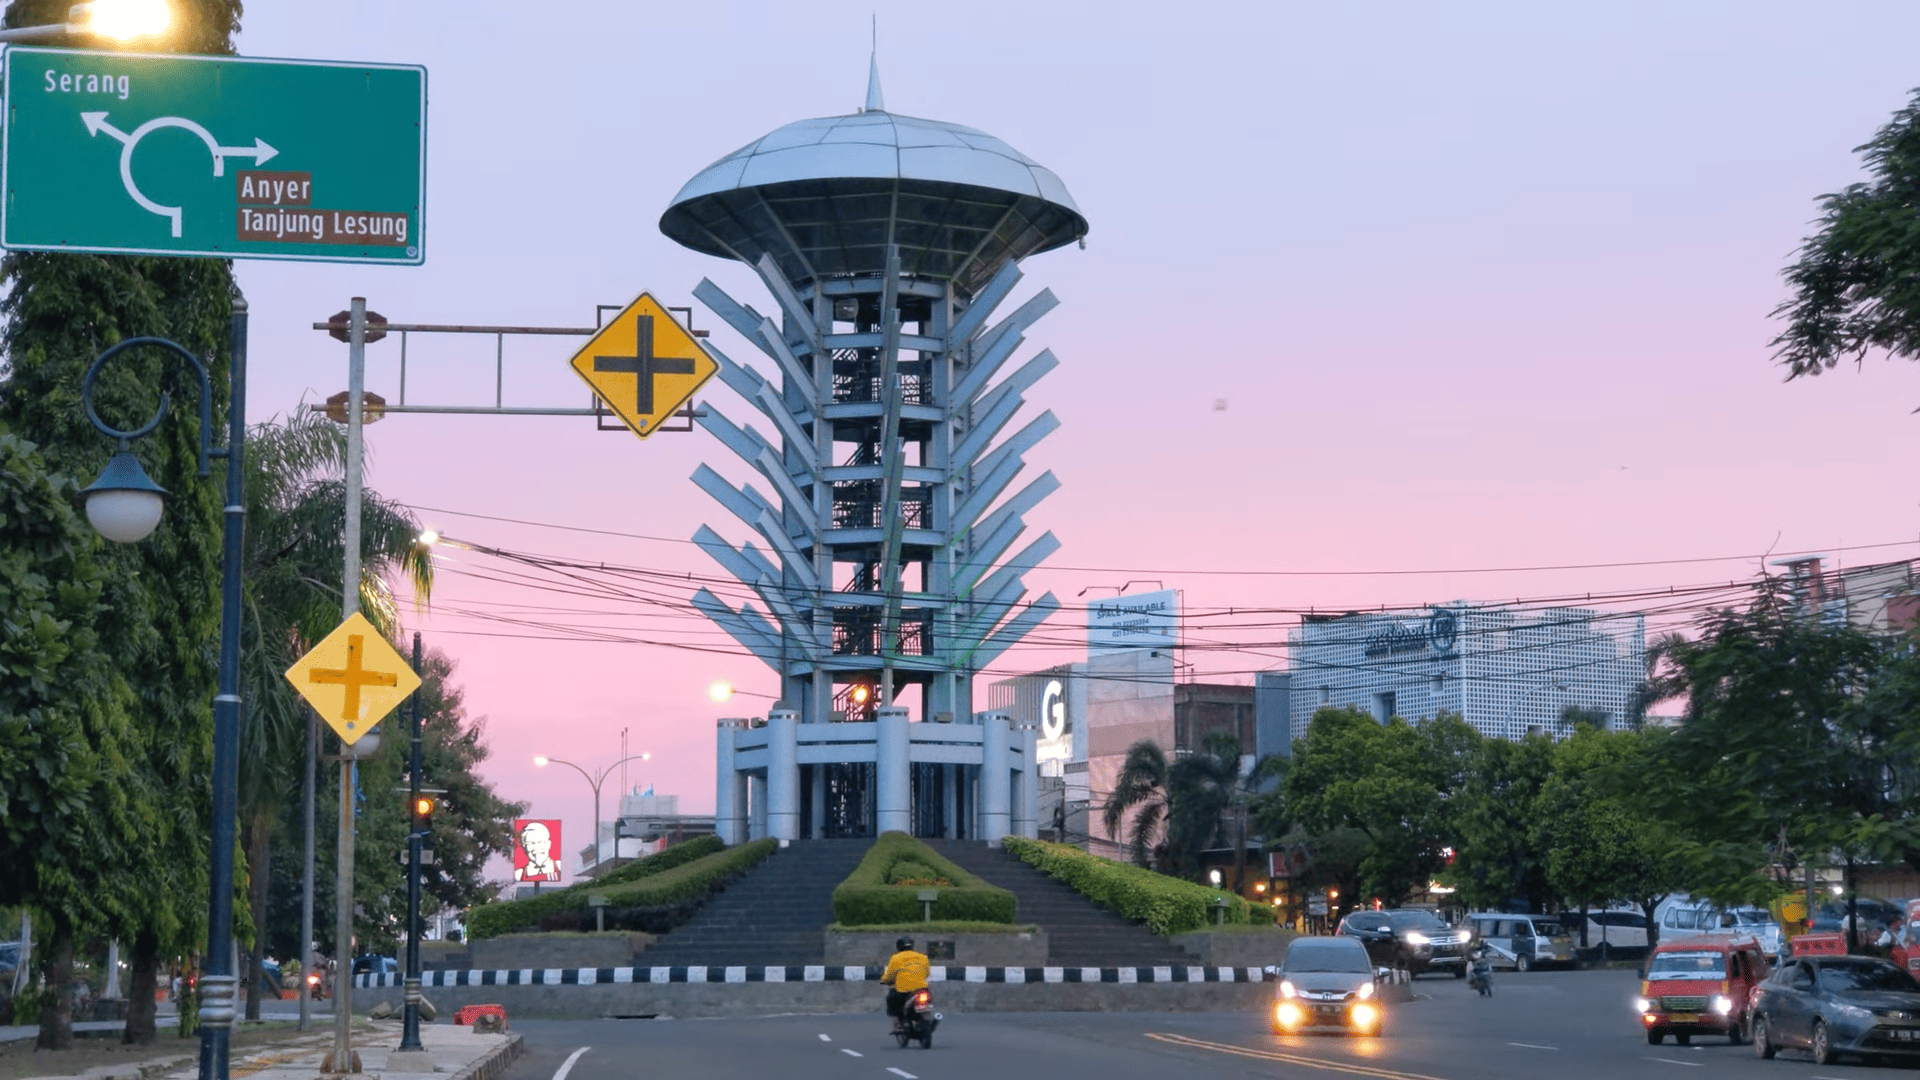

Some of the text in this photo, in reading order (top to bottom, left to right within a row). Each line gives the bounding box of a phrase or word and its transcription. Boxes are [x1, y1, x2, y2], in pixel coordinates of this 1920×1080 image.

[44, 68, 130, 100] Serang
[241, 175, 311, 205] Anyer
[242, 208, 407, 243] Tanjung Lesung
[1123, 602, 1165, 614] AVAILABLE
[1042, 680, 1064, 741] G
